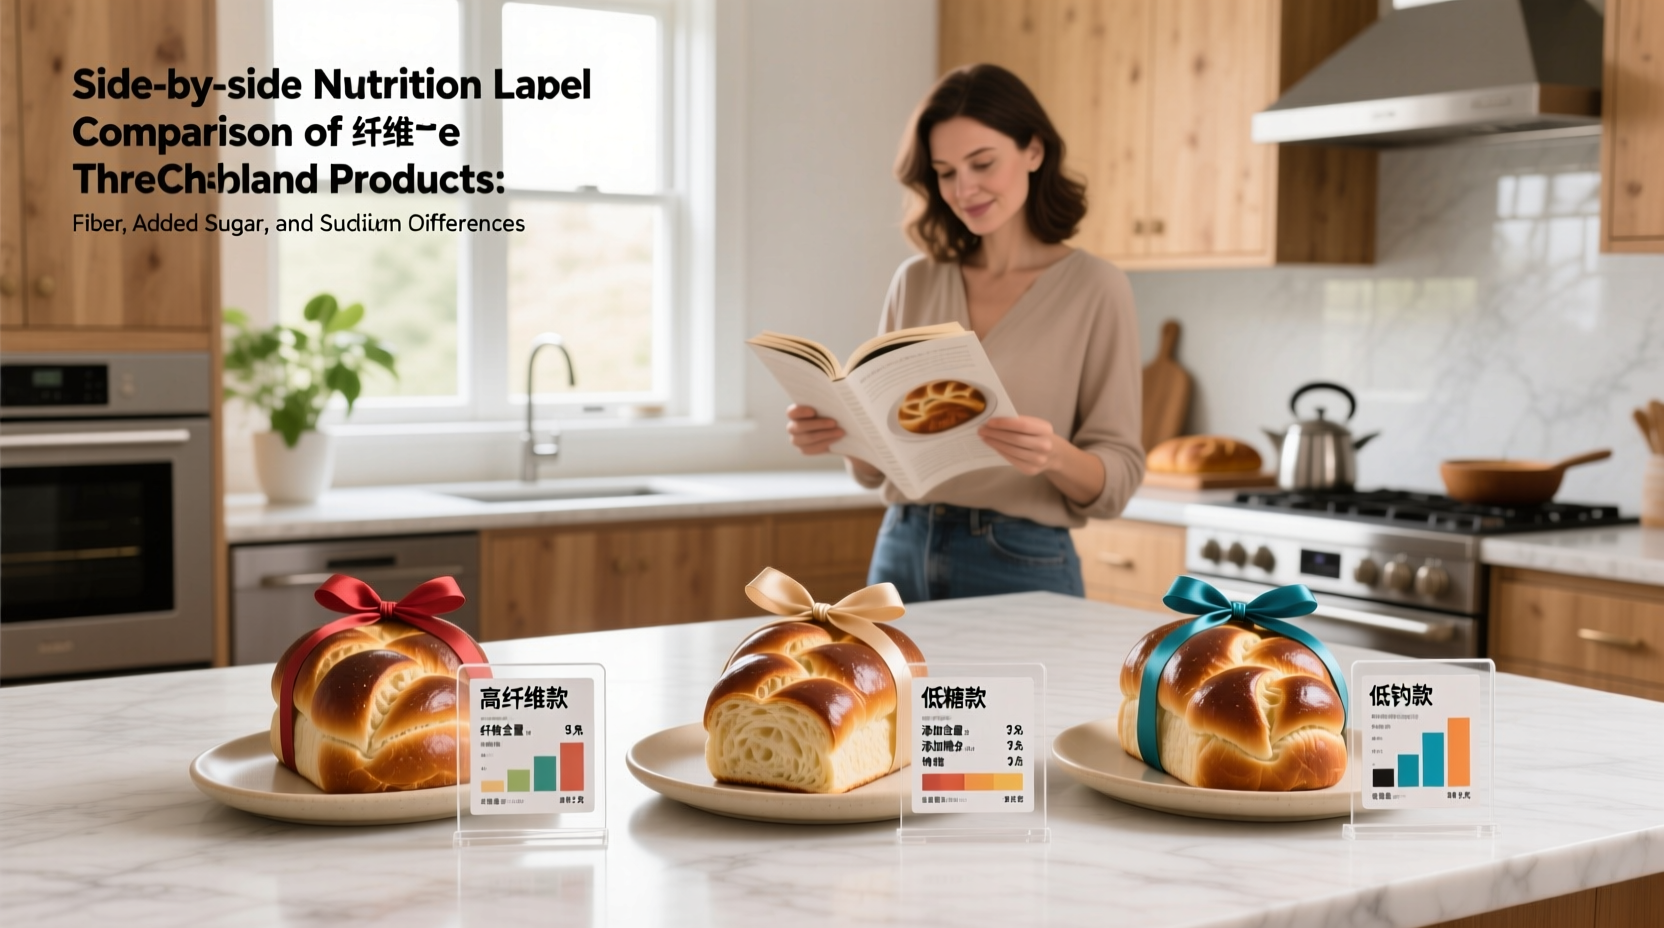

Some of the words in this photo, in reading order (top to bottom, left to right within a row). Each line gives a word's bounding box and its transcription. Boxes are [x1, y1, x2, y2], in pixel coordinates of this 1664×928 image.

[480, 685, 569, 710] 高纤维款
[920, 685, 987, 710] 低糖款
